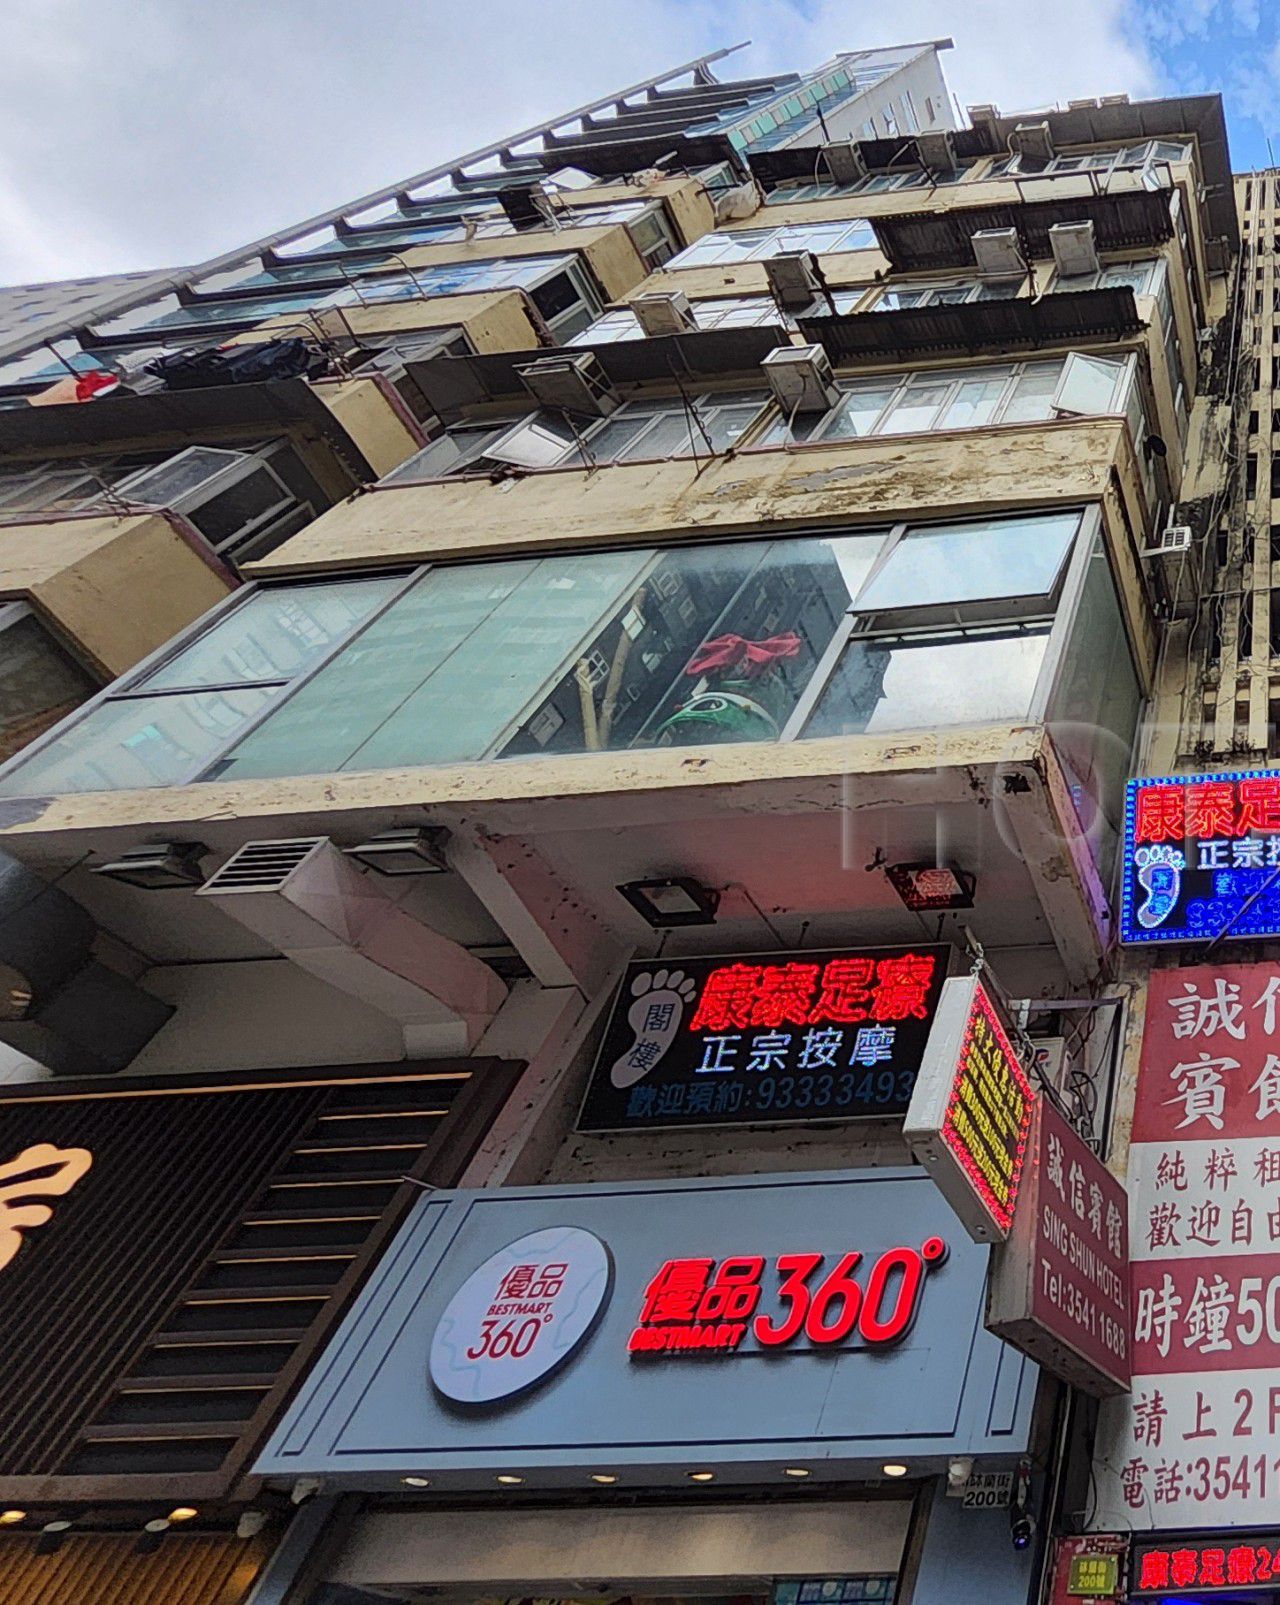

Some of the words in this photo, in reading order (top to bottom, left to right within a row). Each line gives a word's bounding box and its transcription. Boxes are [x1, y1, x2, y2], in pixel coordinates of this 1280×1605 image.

[689, 953, 936, 1032] 康泰足療
[628, 1002, 677, 1072] 閣樓
[695, 1023, 897, 1074] 正宗按摩
[1047, 1132, 1123, 1260] 誠信賓館
[494, 1263, 569, 1300] 優品
[1042, 1204, 1068, 1257] SING
[1069, 1231, 1096, 1282] SHUN
[1097, 1256, 1125, 1310] HOTEL
[487, 1301, 552, 1316] BESTMART
[1041, 1258, 1097, 1337] Tel:3541
[1099, 1304, 1126, 1361] 1688
